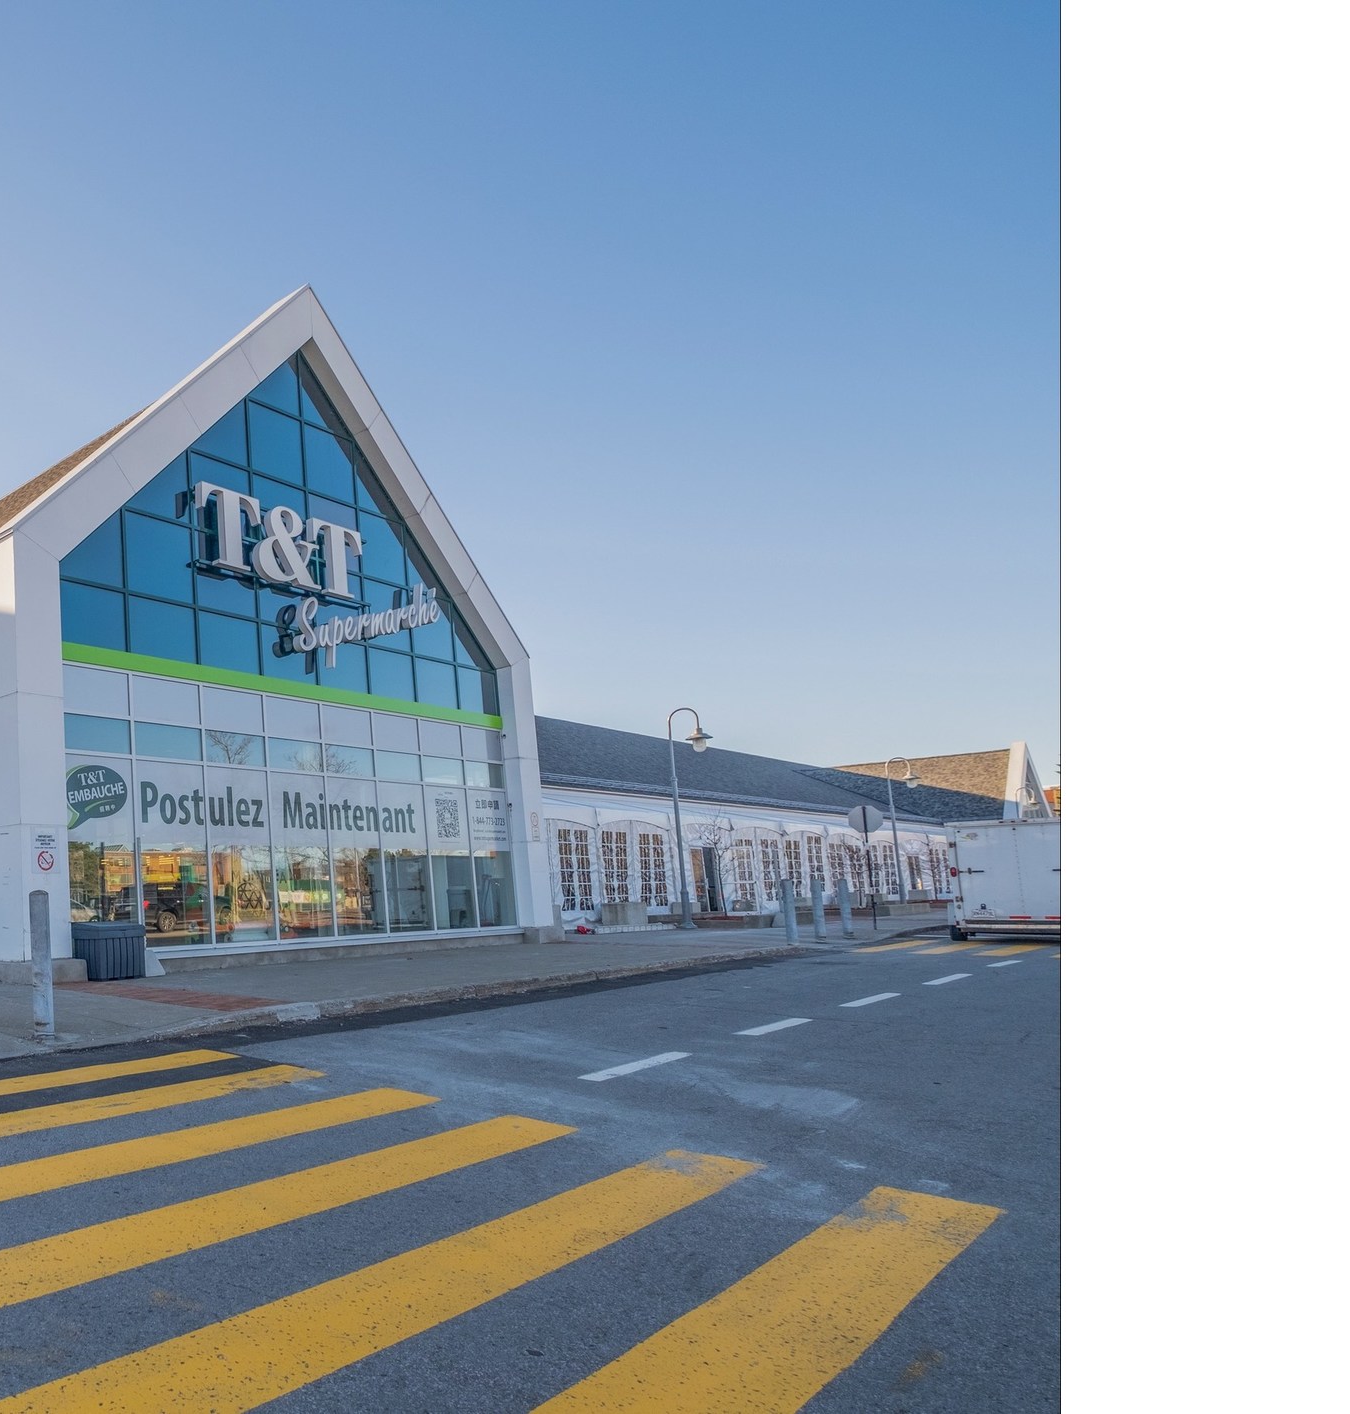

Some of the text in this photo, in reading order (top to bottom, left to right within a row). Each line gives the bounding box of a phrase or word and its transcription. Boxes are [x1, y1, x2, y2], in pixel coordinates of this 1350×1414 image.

[194, 480, 363, 599] T&T
[293, 583, 441, 668] Supermarché
[68, 782, 125, 804] EMBAUCHE
[77, 769, 106, 786] T&T
[140, 781, 416, 833] Postulez Maintenant
